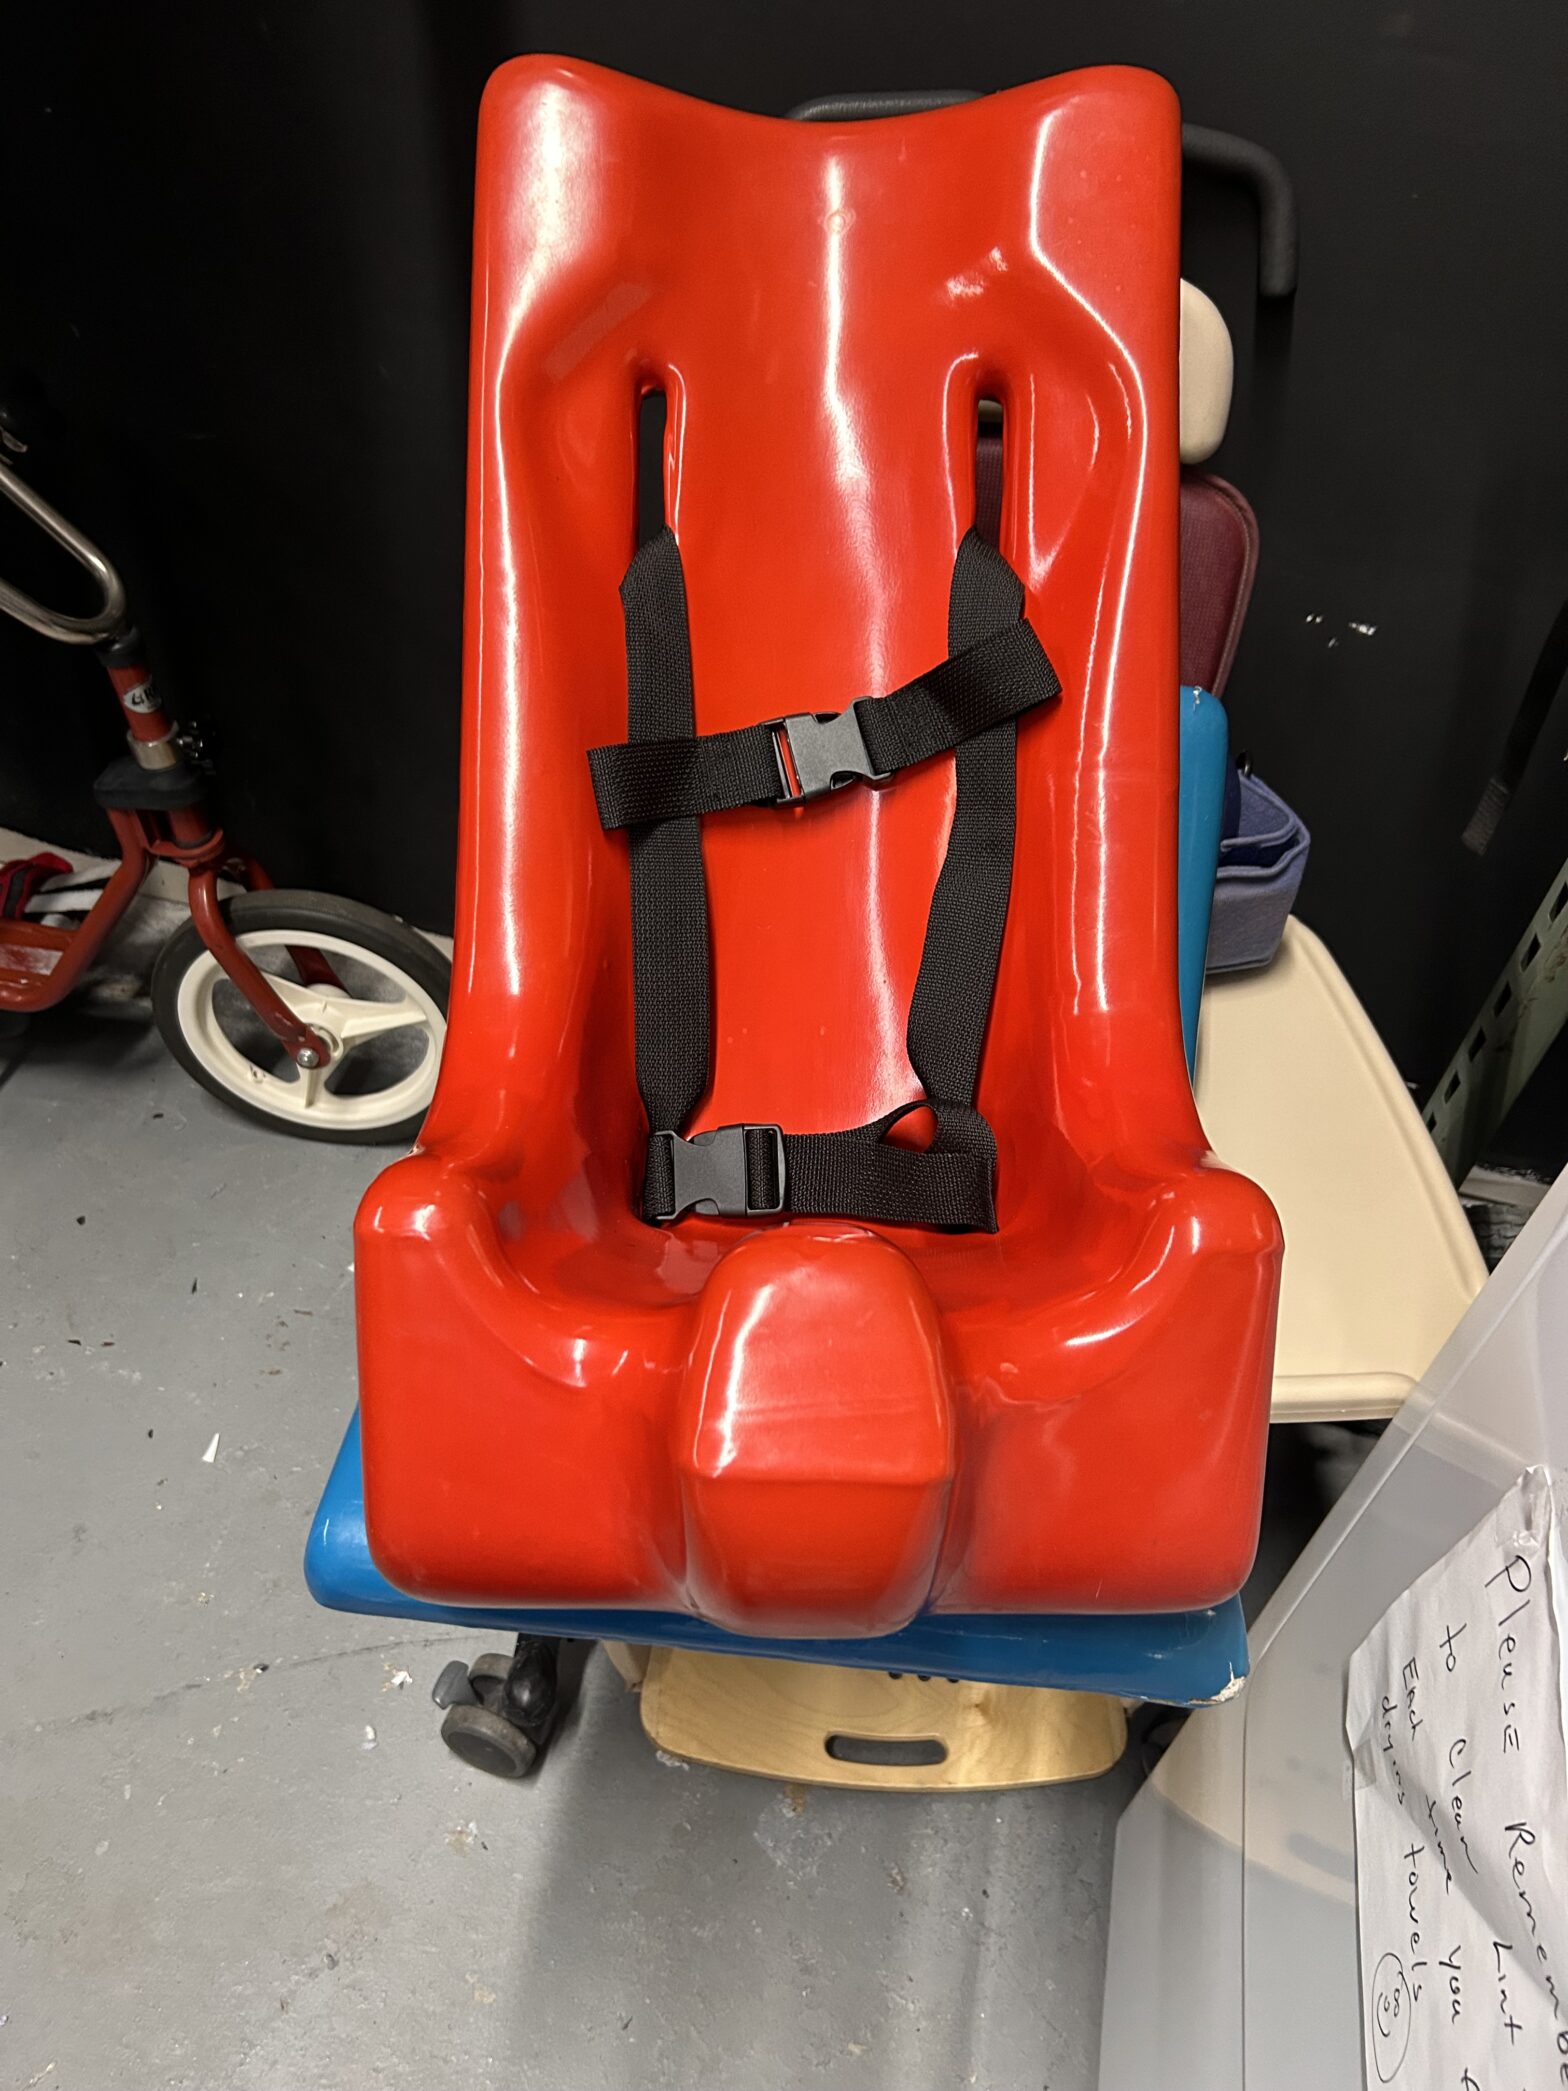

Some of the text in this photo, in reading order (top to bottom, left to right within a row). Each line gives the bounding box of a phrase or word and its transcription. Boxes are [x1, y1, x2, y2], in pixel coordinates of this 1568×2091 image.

[1425, 1794, 1453, 1896] time
[1438, 1622, 1468, 1673] to
[1491, 1940, 1524, 2046] Lint
[1403, 1842, 1428, 2003] towels
[1437, 1944, 1462, 2025] you
